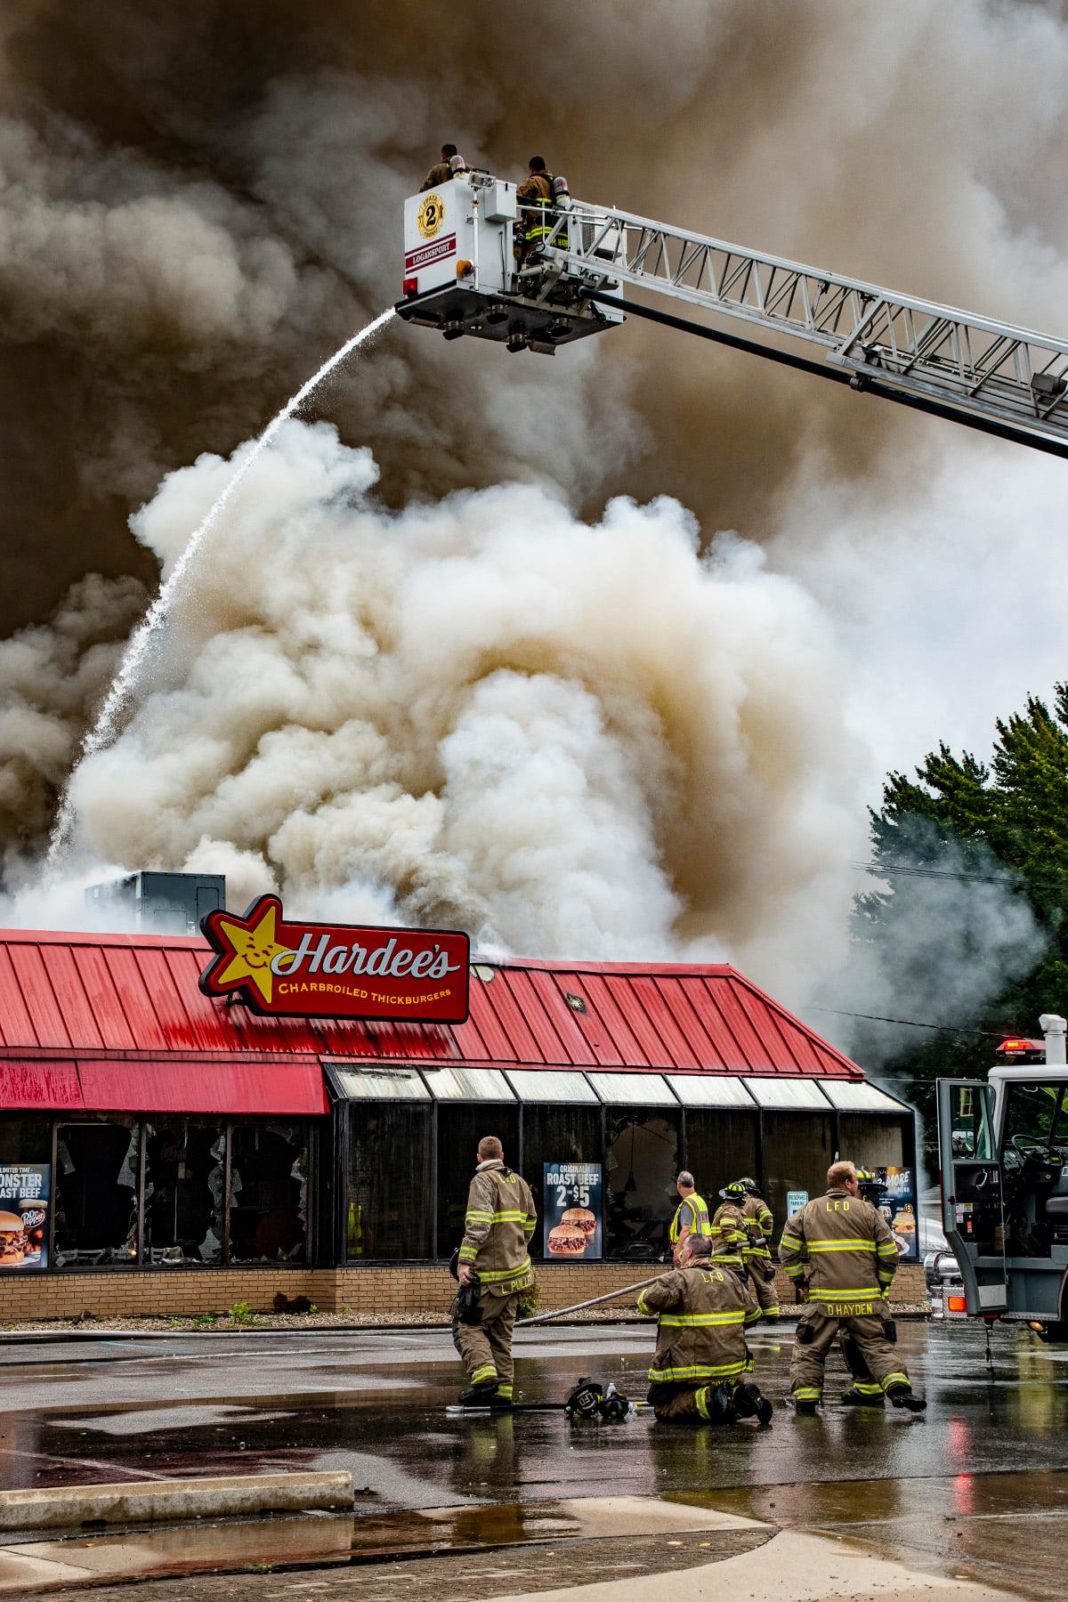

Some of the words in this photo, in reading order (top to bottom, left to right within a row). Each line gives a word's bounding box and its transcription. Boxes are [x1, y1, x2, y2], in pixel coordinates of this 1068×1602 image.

[426, 205, 436, 227] 2
[412, 242, 451, 265] LOGANSPORT
[270, 933, 461, 979] Hardee's
[278, 982, 368, 999] CHARBROILED
[371, 988, 451, 1005] THICKBURGERS
[0, 1173, 42, 1187] ONSTER
[547, 1173, 576, 1185] ROAST
[577, 1173, 599, 1185] BEEF
[886, 1170, 910, 1187] MORE
[0, 1188, 17, 1198] AST
[20, 1188, 40, 1198] BEEF
[826, 1200, 850, 1212] LFD
[702, 1271, 724, 1283] LFD
[836, 1303, 873, 1316] HAYDEN
